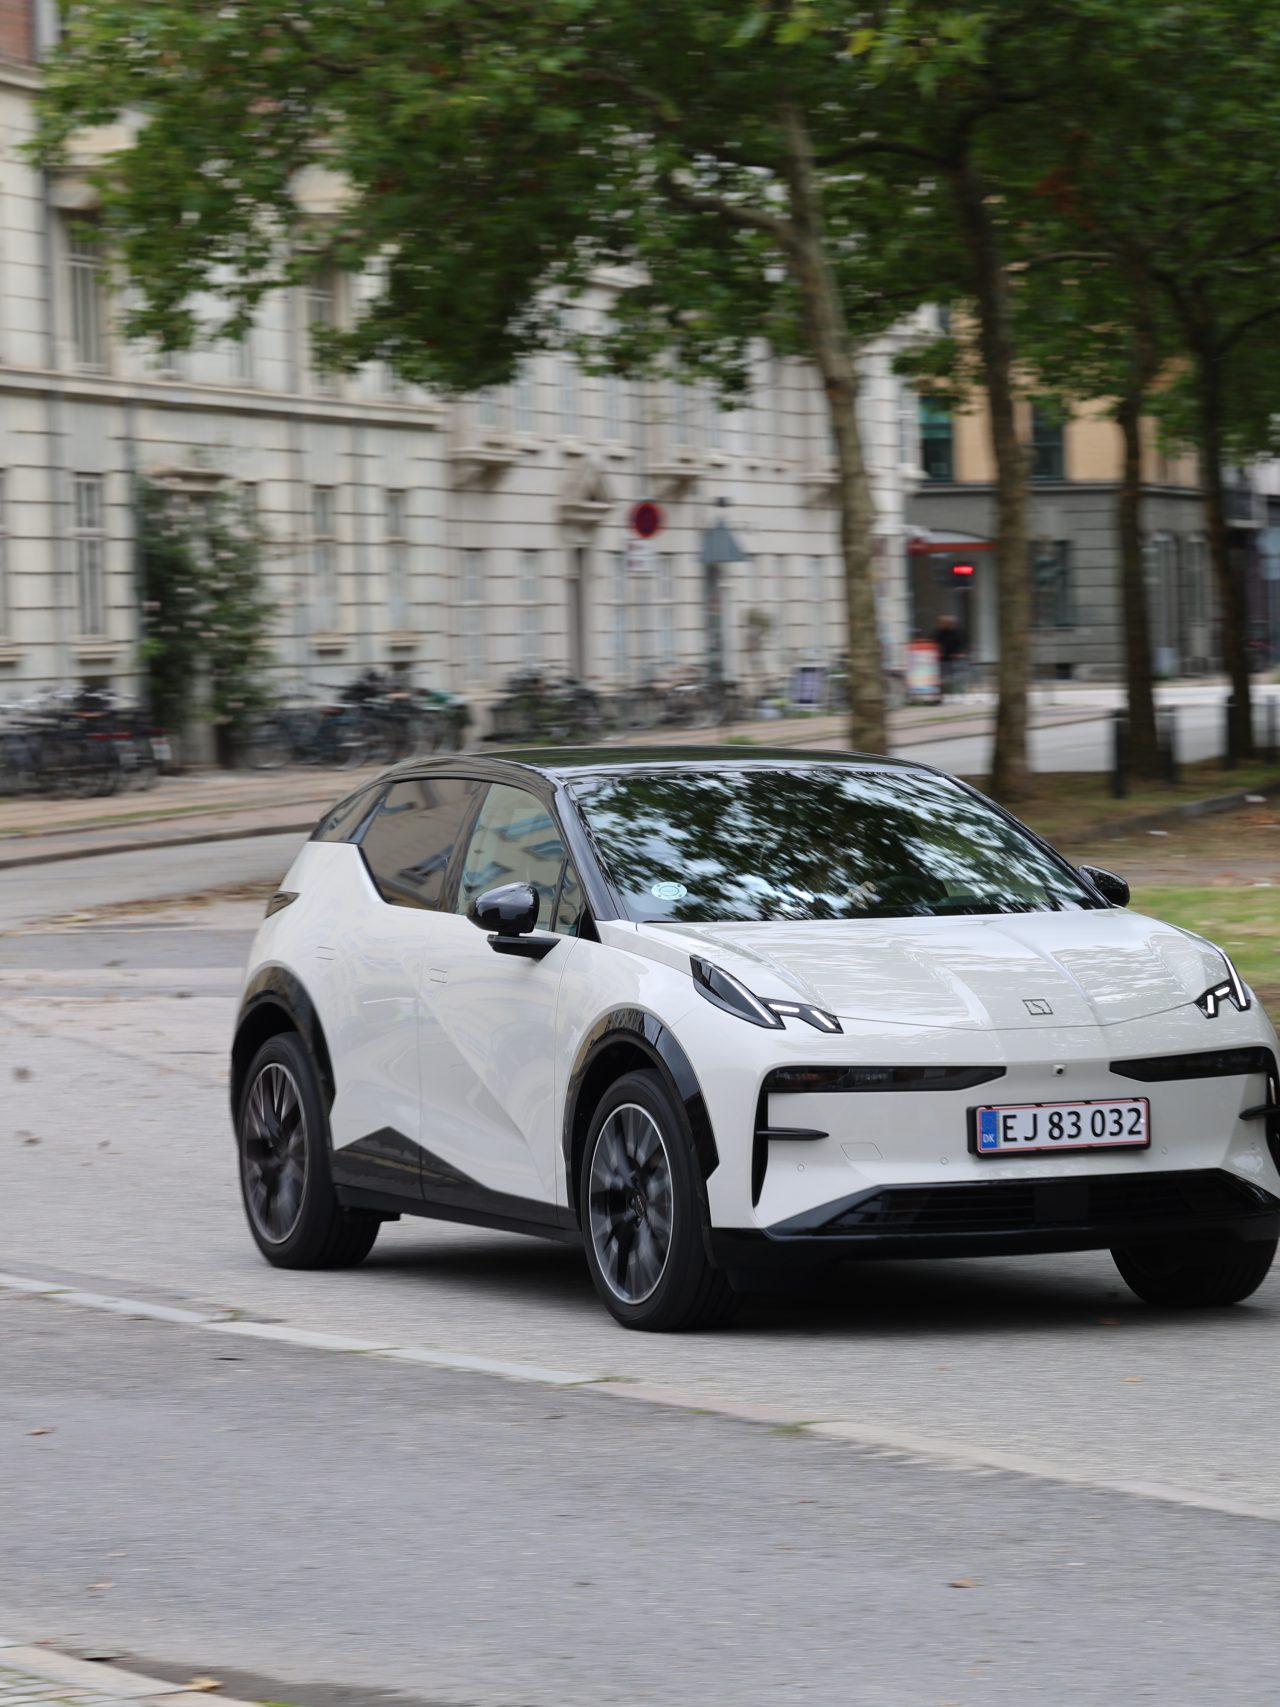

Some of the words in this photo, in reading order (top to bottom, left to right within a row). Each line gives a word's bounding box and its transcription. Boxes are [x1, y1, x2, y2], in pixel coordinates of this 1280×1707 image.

[1002, 1113, 1038, 1143] EJ
[1048, 1110, 1082, 1140] 83
[1090, 1107, 1143, 1138] 032
[982, 1133, 996, 1144] DK
